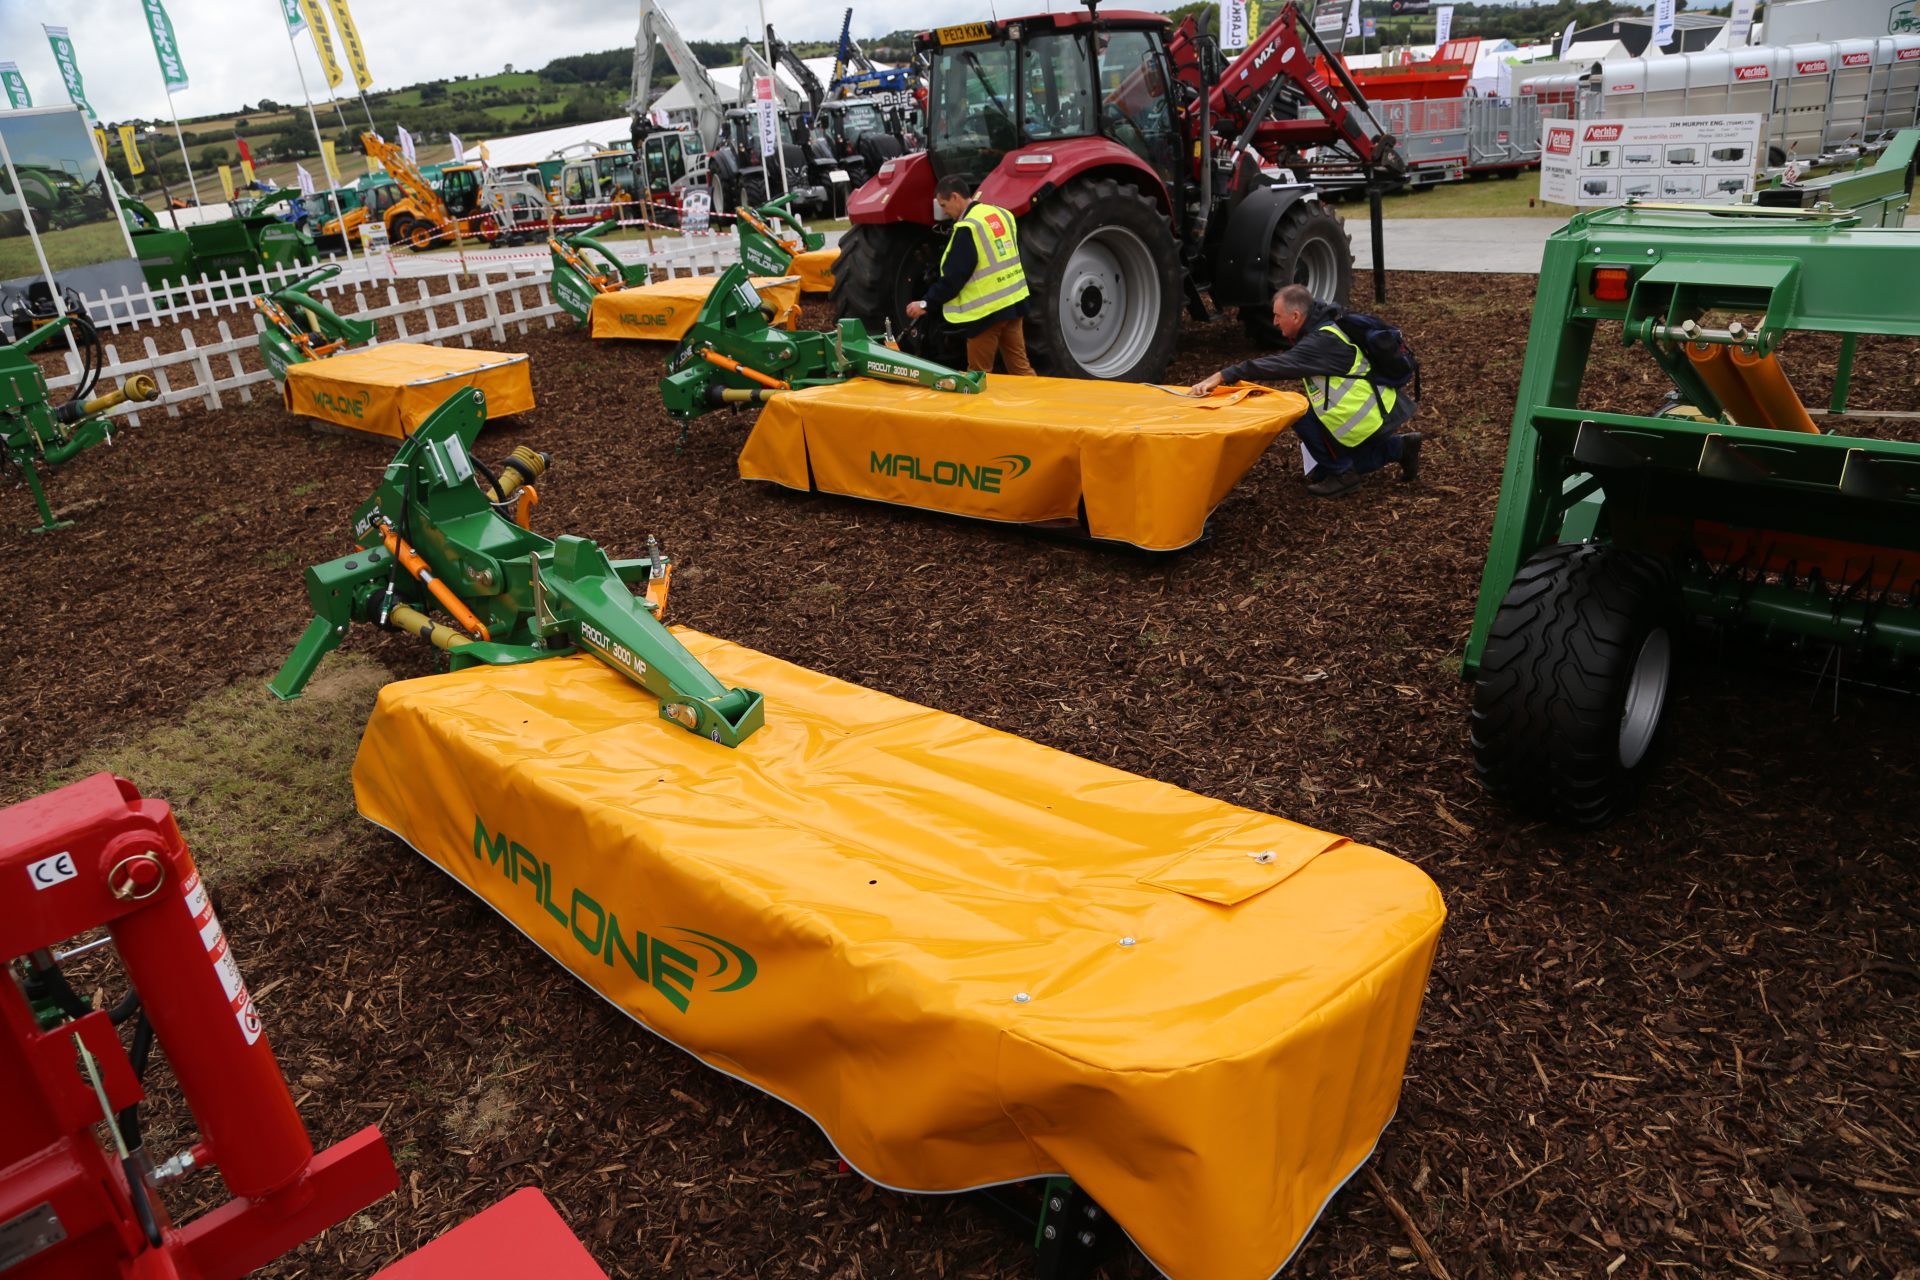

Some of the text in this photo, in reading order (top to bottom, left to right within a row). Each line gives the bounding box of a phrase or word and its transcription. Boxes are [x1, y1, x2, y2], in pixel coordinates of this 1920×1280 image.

[1253, 42, 1277, 70] MX
[1586, 124, 1619, 140] Aerlite
[619, 312, 667, 327] MALONE
[867, 360, 920, 378] PROCUT 3000 MP
[870, 451, 1003, 494] MALONE
[581, 621, 647, 675] PROCUT 3000 MP
[474, 813, 699, 1015] MALONE
